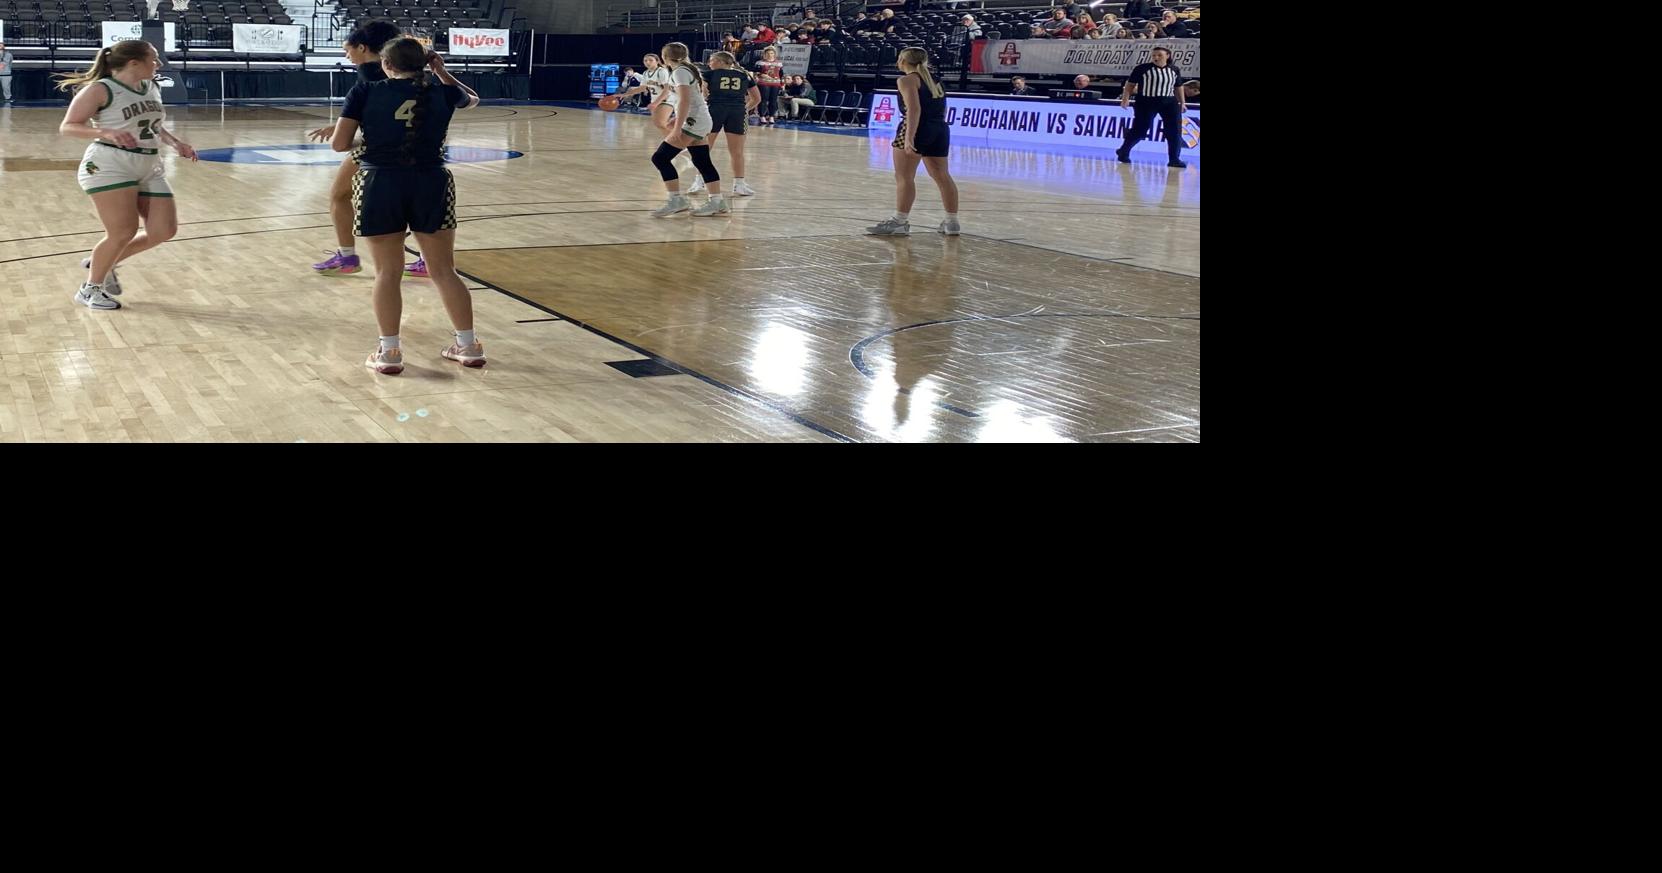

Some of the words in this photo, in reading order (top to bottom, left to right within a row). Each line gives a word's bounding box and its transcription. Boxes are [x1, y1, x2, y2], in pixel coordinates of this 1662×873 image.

[453, 34, 504, 48] HyVee
[1064, 50, 1133, 65] HOLIDAY
[1136, 51, 1195, 65] HPS
[720, 77, 740, 89] 23
[395, 100, 416, 127] 4
[1047, 112, 1067, 134] VS
[1073, 114, 1166, 142] SAVANAH
